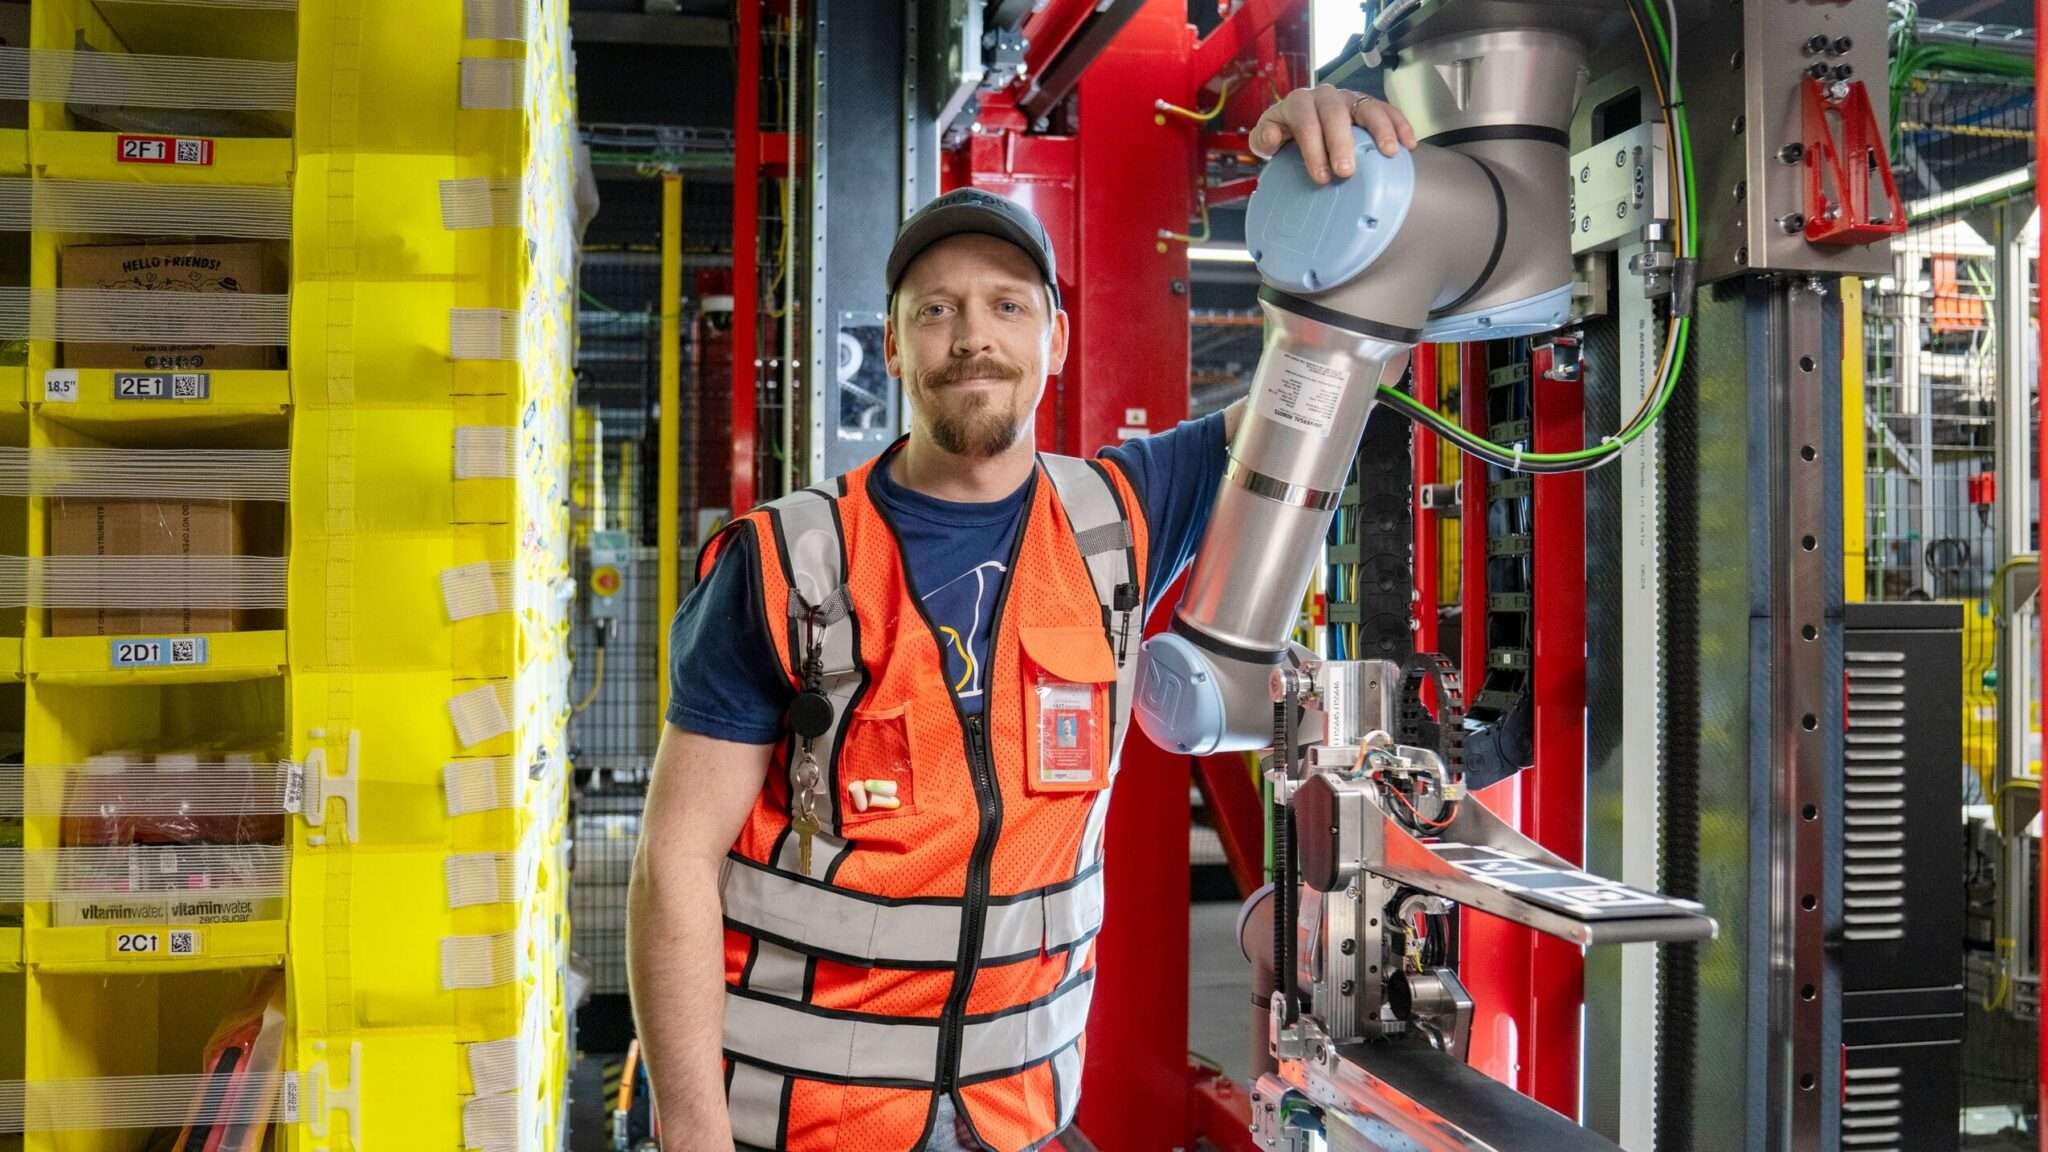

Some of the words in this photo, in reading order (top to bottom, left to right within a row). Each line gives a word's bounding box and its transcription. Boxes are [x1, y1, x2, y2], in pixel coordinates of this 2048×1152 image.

[125, 141, 152, 158] 2F
[122, 256, 161, 273] HELLO
[47, 380, 76, 392] 18.5"
[122, 378, 150, 395] 2E
[120, 644, 149, 661] 2D
[118, 934, 147, 951] 2C
